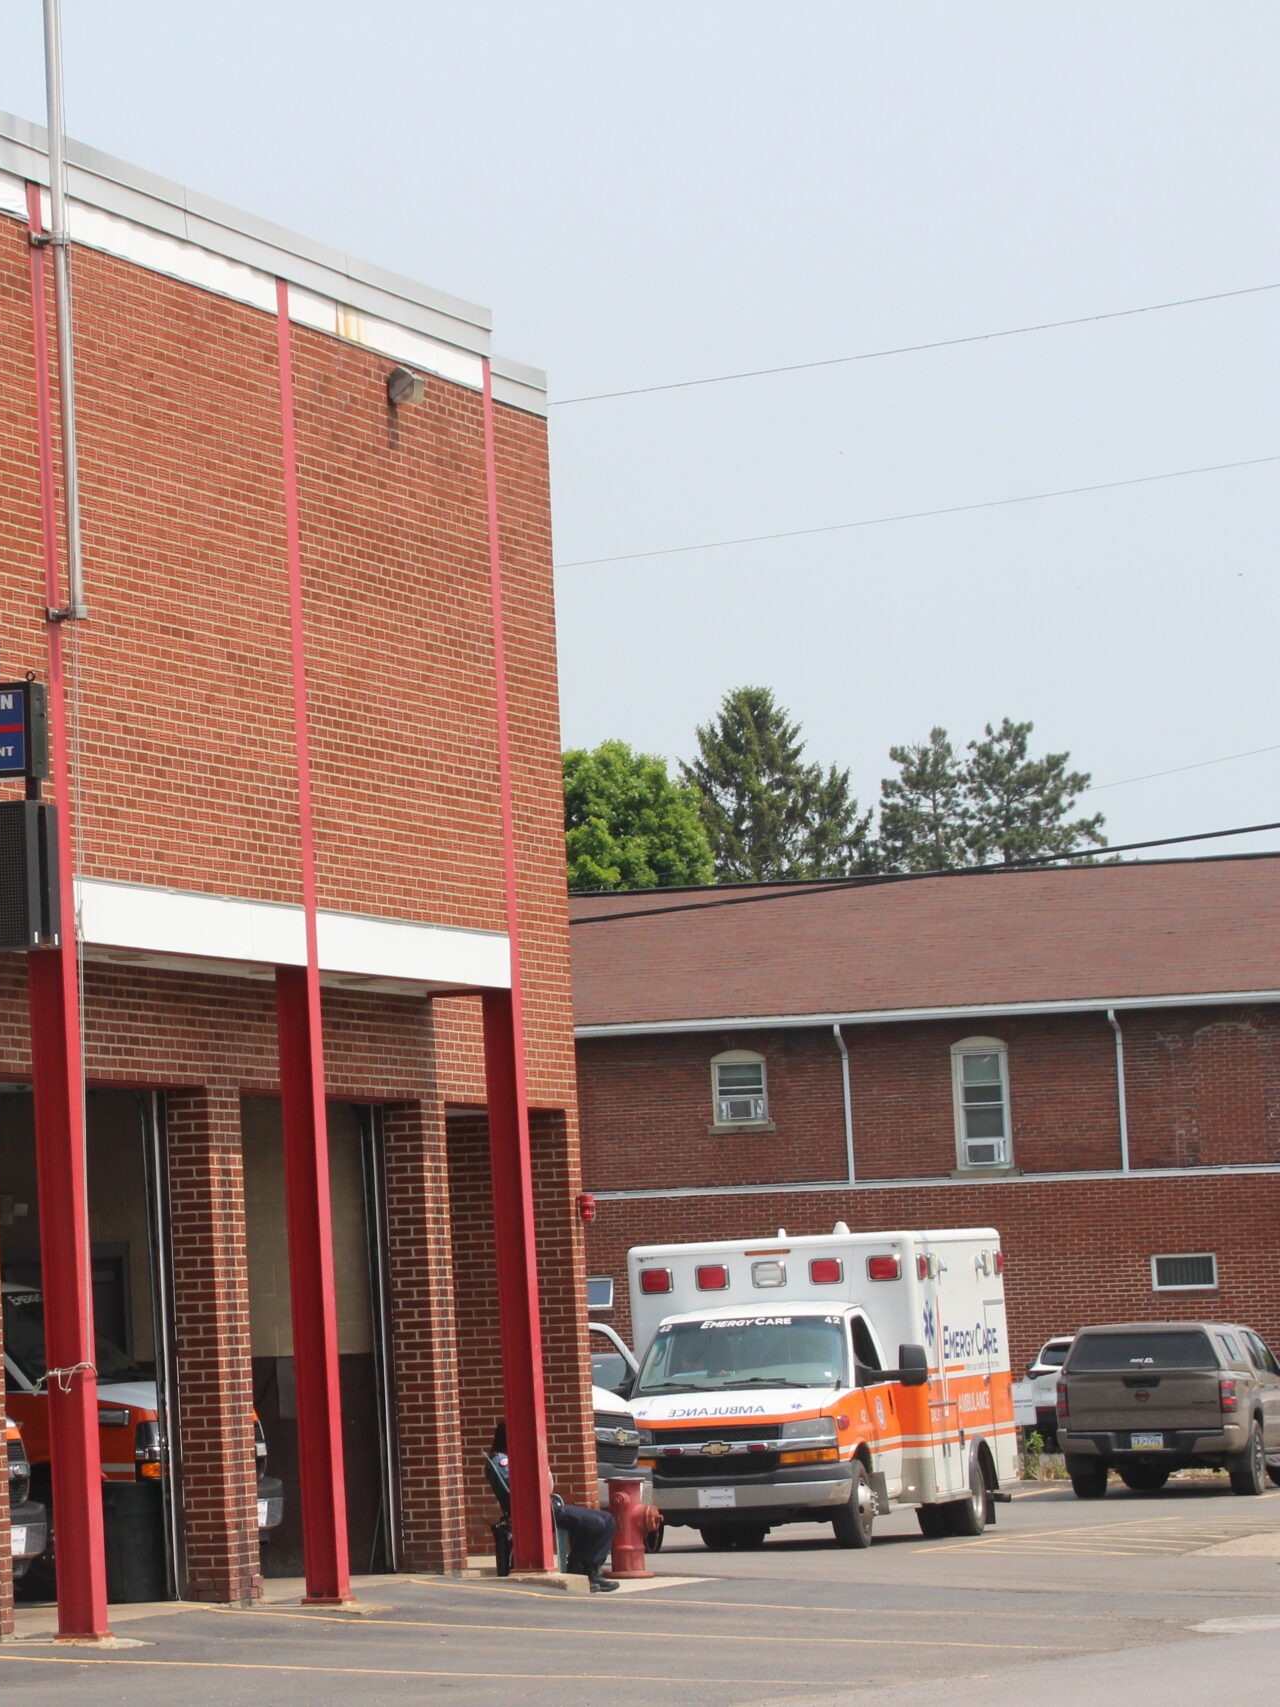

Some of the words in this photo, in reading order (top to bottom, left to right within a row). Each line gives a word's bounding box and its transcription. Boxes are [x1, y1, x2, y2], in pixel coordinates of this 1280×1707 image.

[824, 1316, 841, 1325] 42
[659, 1325, 672, 1333] 42
[958, 1390, 991, 1413] AMBULANCE
